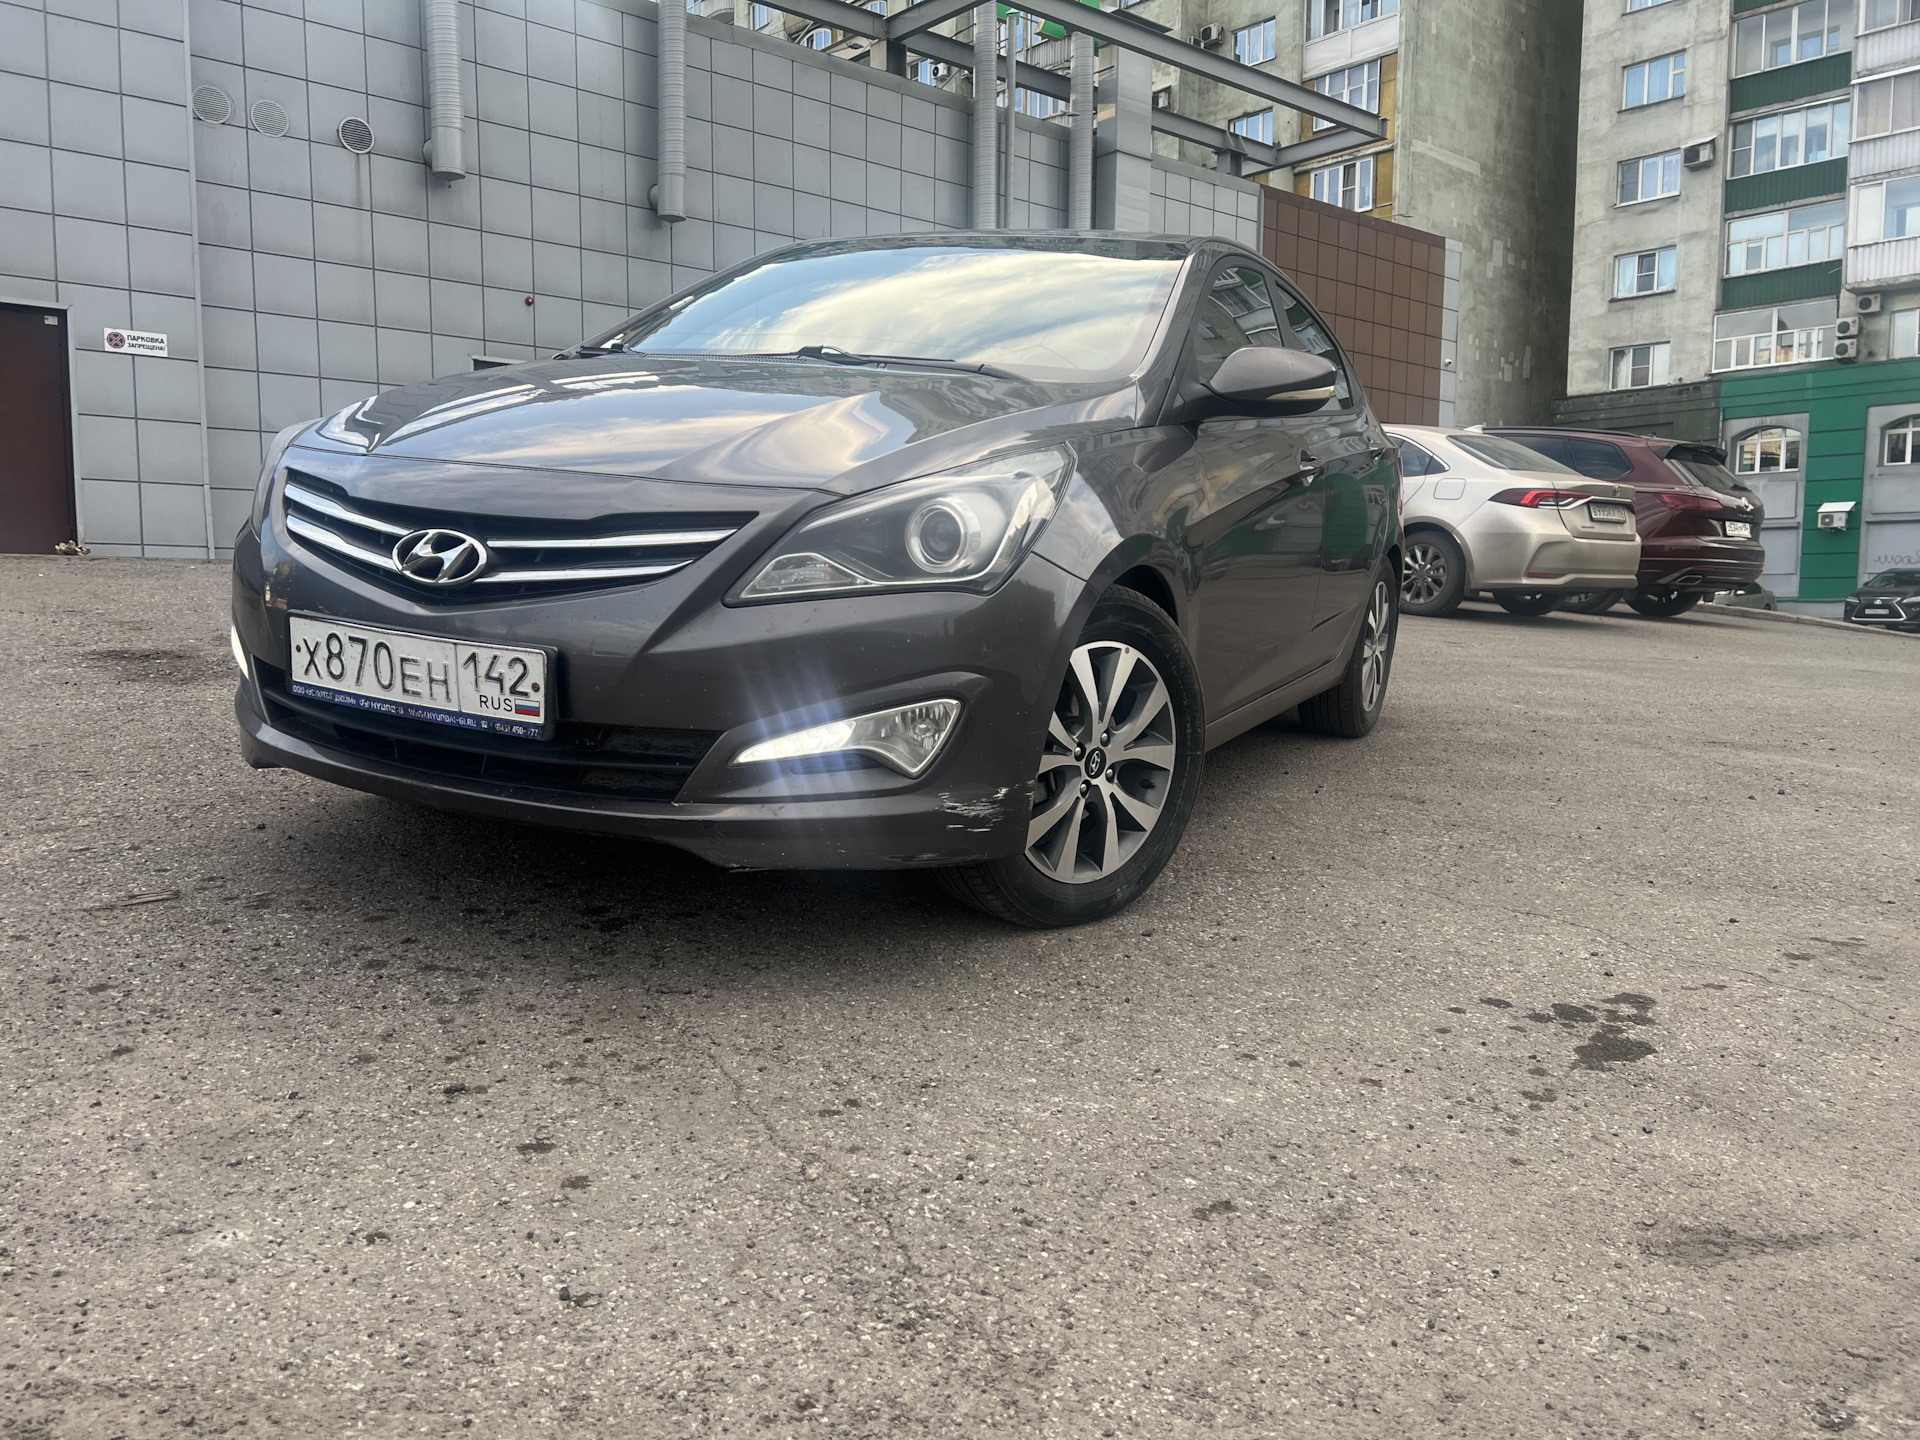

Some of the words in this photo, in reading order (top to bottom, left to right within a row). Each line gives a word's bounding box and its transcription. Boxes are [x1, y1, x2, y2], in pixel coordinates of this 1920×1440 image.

[127, 334, 165, 344] ПАРКОВКА
[127, 343, 166, 351] ЗАПРЕЩЕНА!
[303, 631, 451, 702] Х870ЕН
[461, 651, 530, 697] 142
[479, 694, 513, 713] RUS
